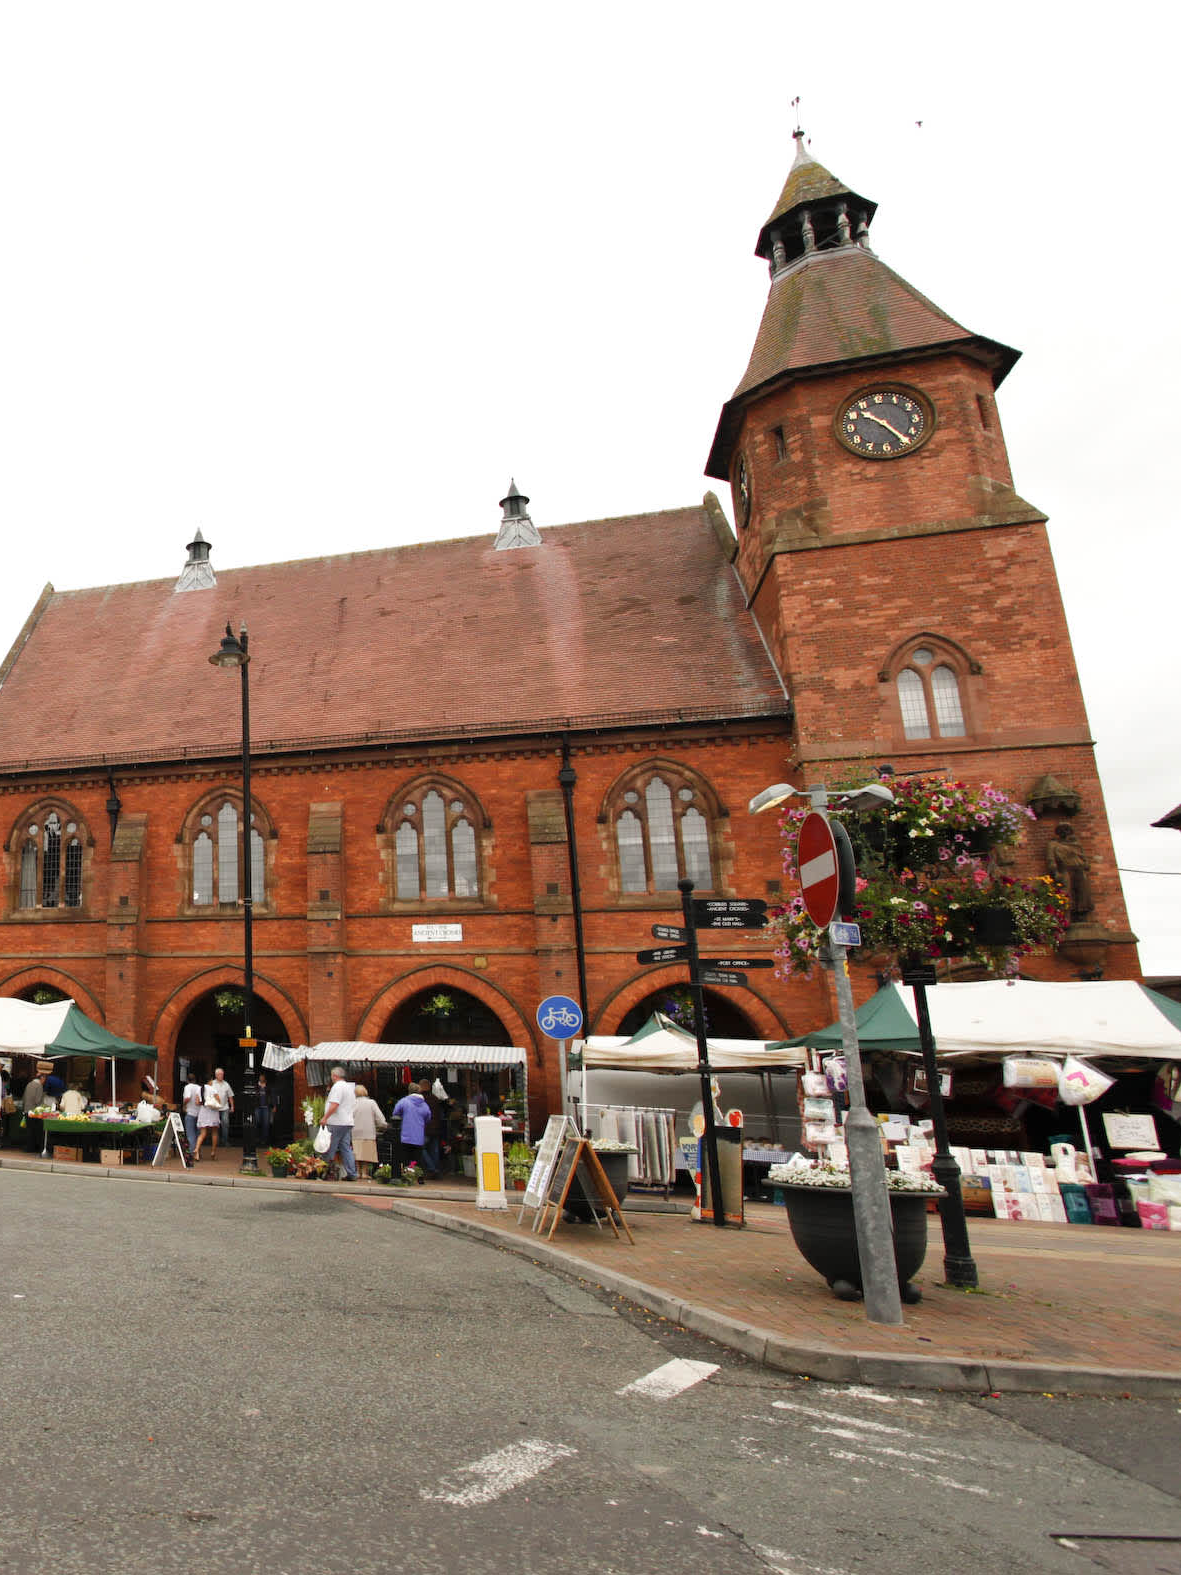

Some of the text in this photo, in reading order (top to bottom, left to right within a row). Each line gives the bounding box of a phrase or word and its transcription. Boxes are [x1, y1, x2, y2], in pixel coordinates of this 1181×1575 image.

[874, 395, 883, 404] 12
[892, 396, 898, 404] 1
[859, 401, 868, 409] 11
[905, 402, 913, 411] 2
[849, 411, 859, 420] 10
[911, 413, 920, 423] 3
[847, 423, 856, 433] 9
[908, 426, 917, 435] 4
[853, 434, 861, 444] 8
[866, 442, 875, 450] 7
[882, 442, 891, 451] 6
